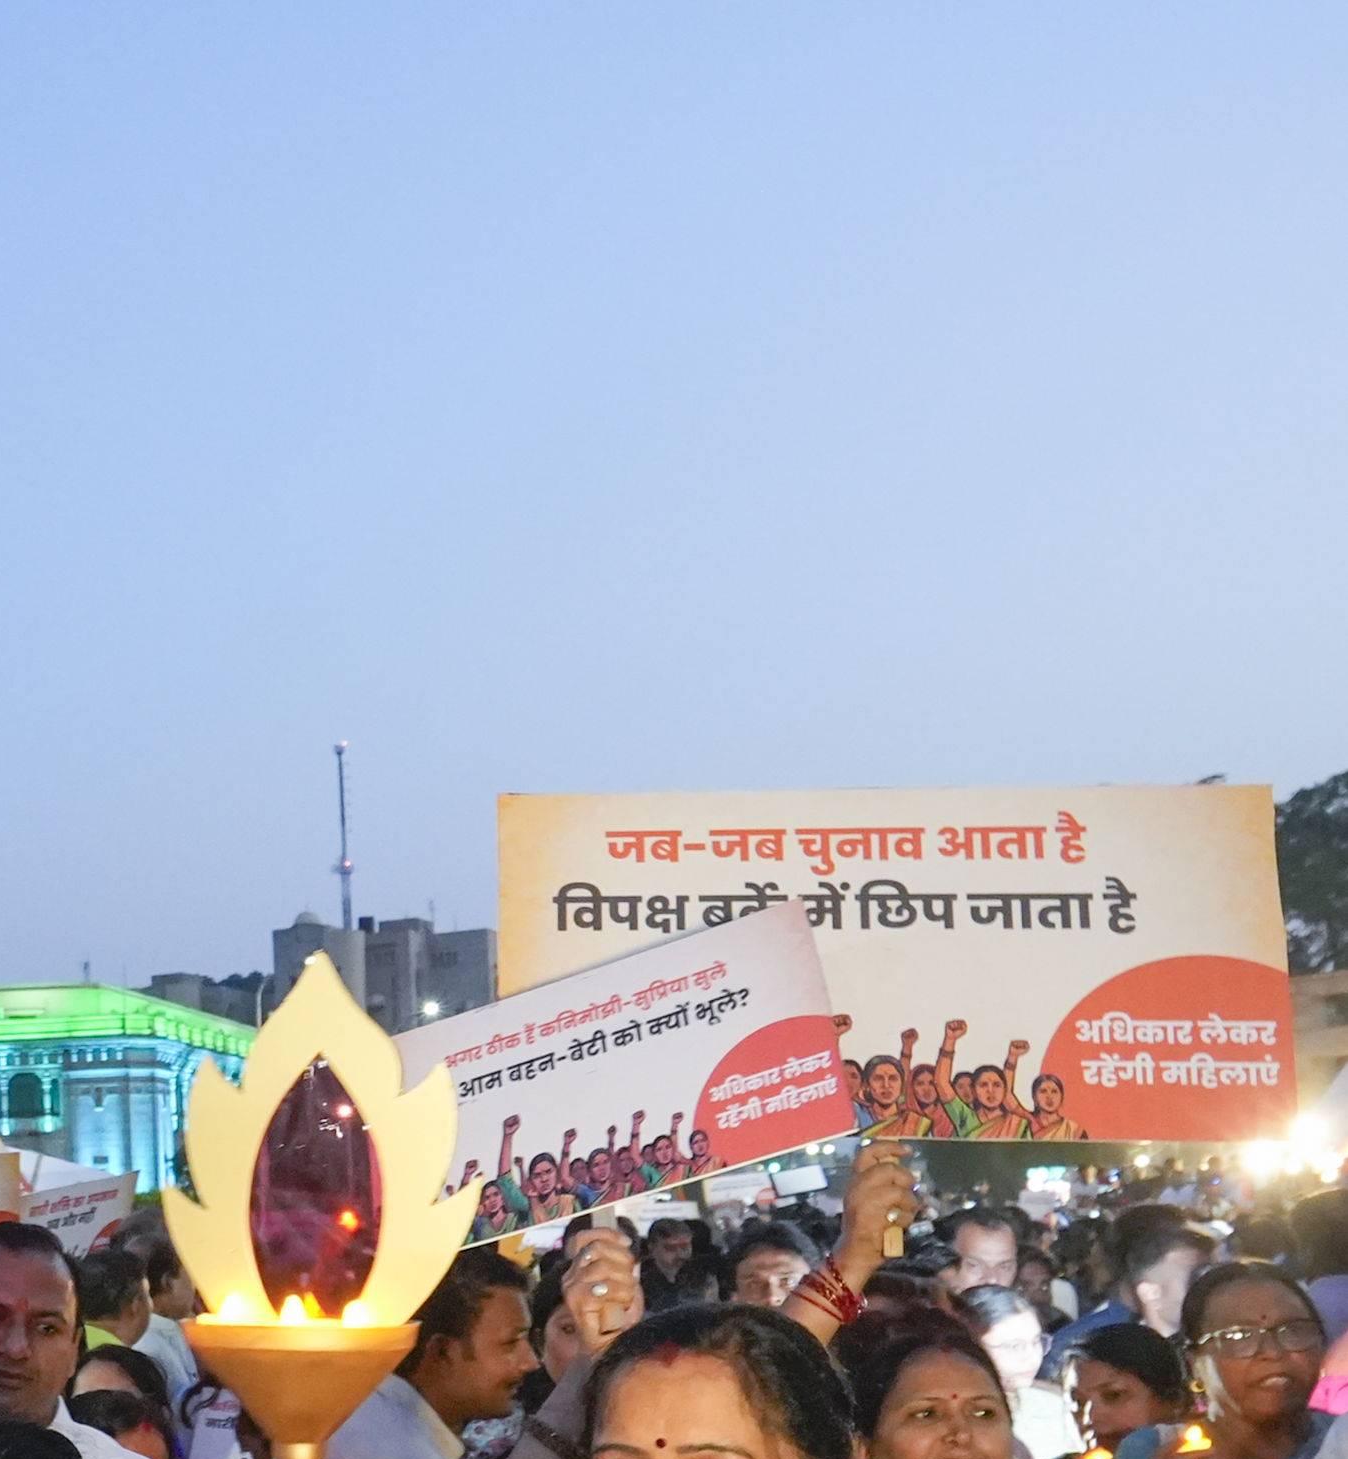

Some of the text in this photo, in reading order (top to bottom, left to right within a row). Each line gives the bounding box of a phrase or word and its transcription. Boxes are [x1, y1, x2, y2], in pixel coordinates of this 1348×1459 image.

[606, 811, 1086, 875] जब-जब चुनाव आता है
[553, 882, 689, 933] विपक्ष
[798, 882, 850, 929] में
[855, 880, 957, 929] छिप
[967, 893, 1093, 929] जाता
[1103, 877, 1137, 934] है
[444, 1045, 483, 1068] अगर
[485, 1032, 521, 1055] ठीक
[538, 975, 688, 1036] कनिमोझी-सुप्रिया
[691, 961, 726, 990] सुले
[459, 988, 749, 1097] आम बहन-बेटी को क्यों भूले?
[1076, 1013, 1277, 1048] अधिकार लेकर
[709, 1050, 832, 1101] अधिकार लेकर
[1081, 1052, 1280, 1088] रहेंगी महिलाएं
[716, 1074, 837, 1129] रहेंगी महिलाएं
